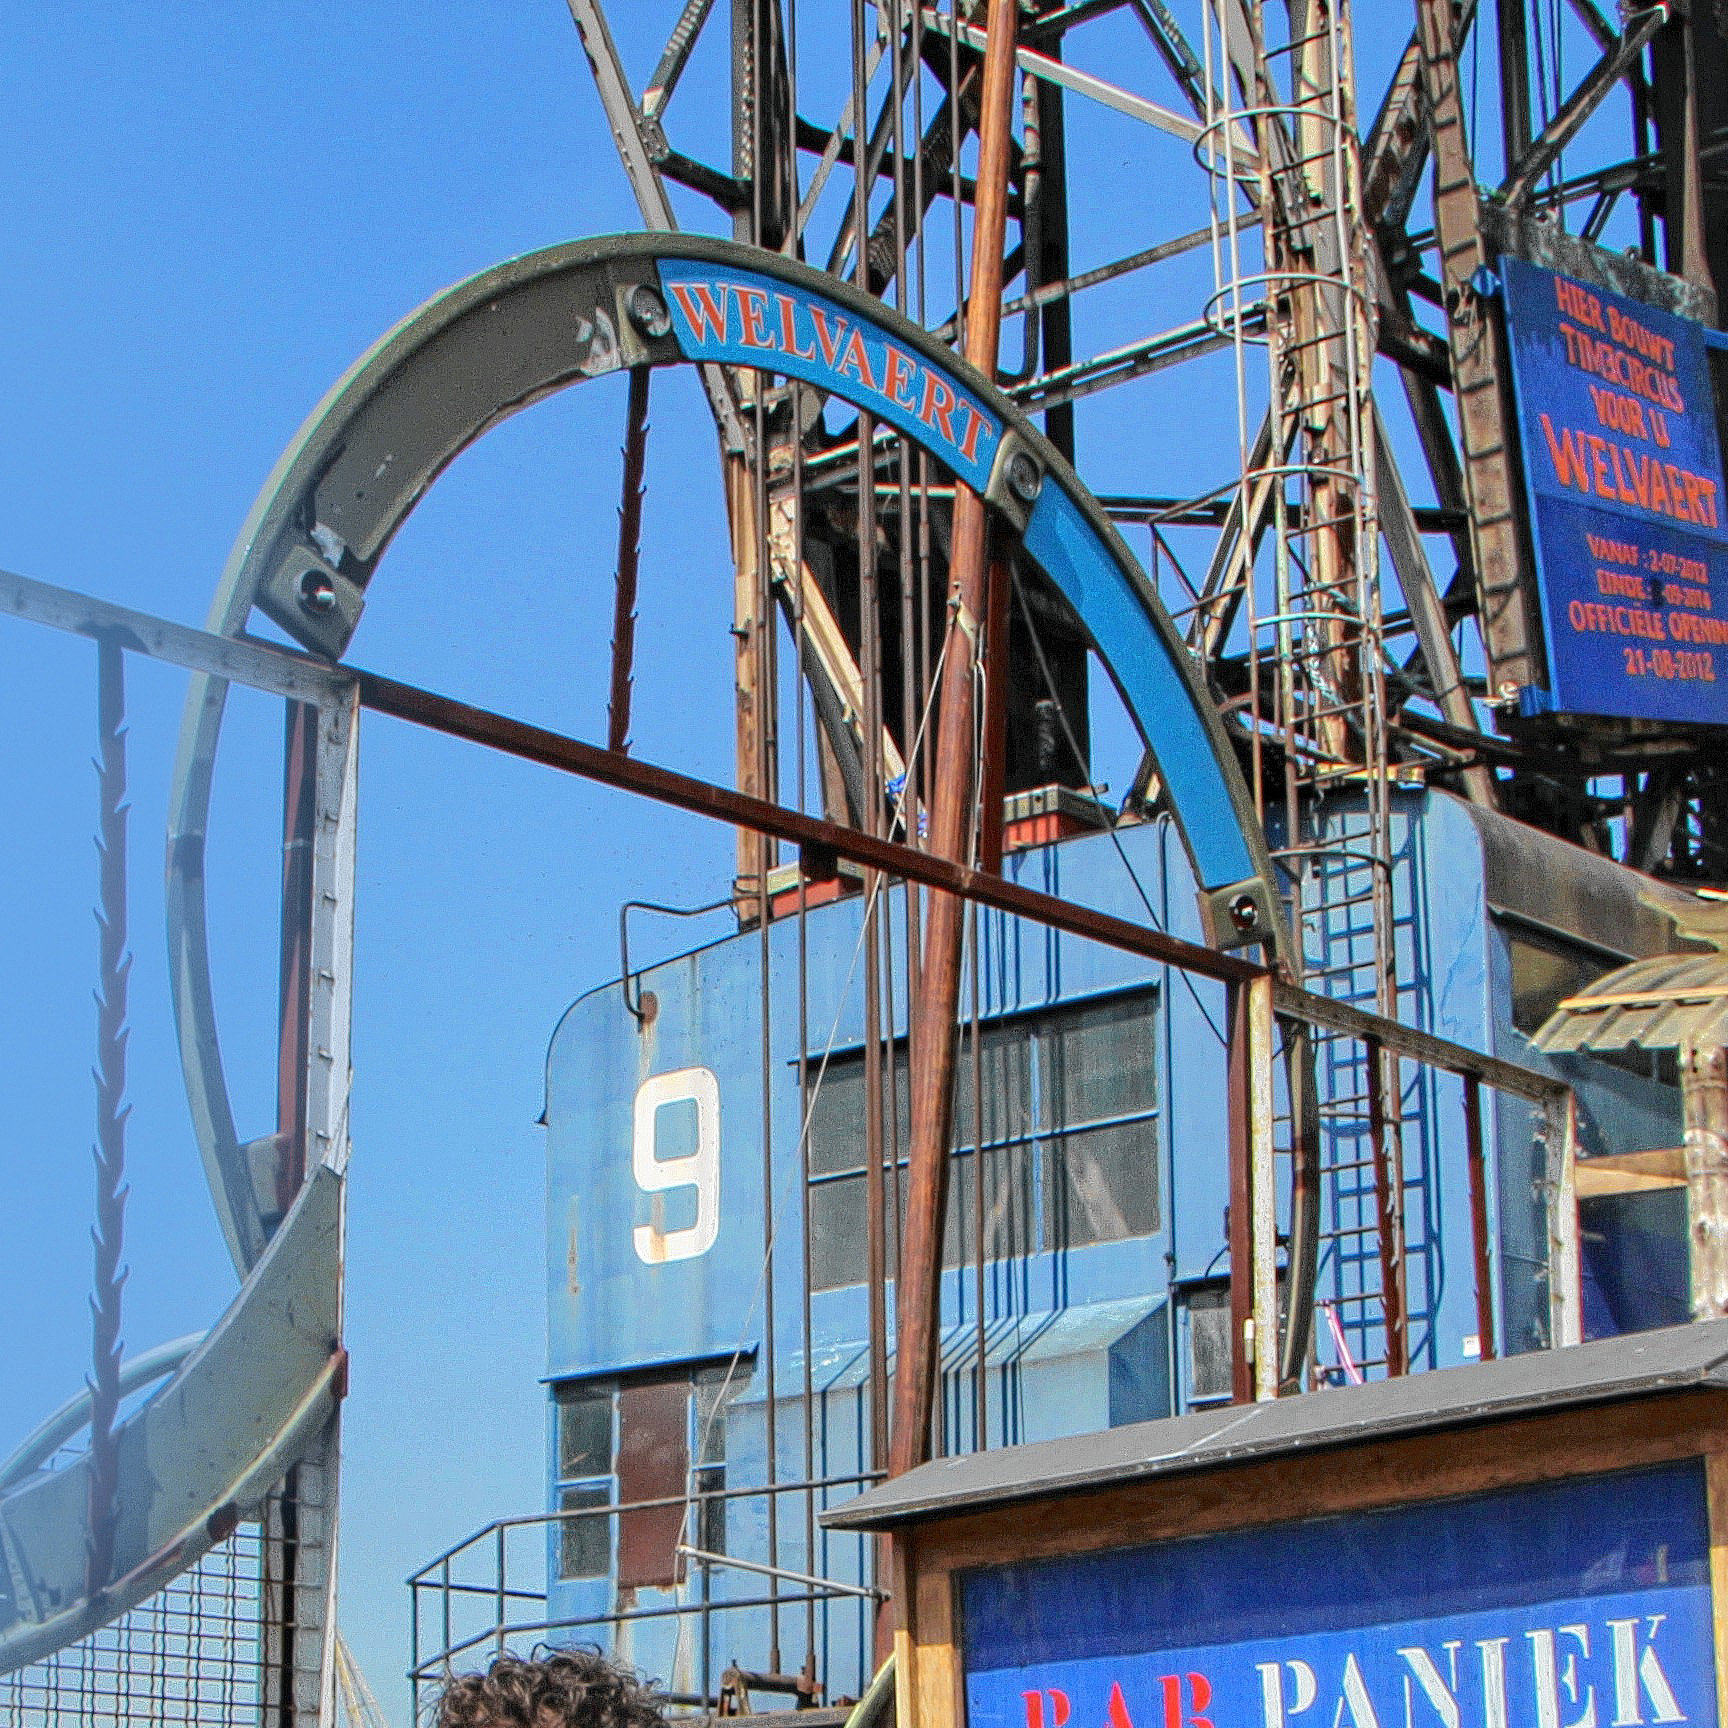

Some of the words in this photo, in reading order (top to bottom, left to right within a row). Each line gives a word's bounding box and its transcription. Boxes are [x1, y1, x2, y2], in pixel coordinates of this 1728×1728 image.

[671, 282, 992, 464] WELVAERT
[1554, 275, 1607, 334] HIER
[1607, 304, 1675, 371] BOUWT
[1539, 412, 1718, 528] WELVAERT
[1588, 383, 1649, 441] VOOR
[1648, 407, 1671, 448] U
[633, 1066, 721, 1265] 9
